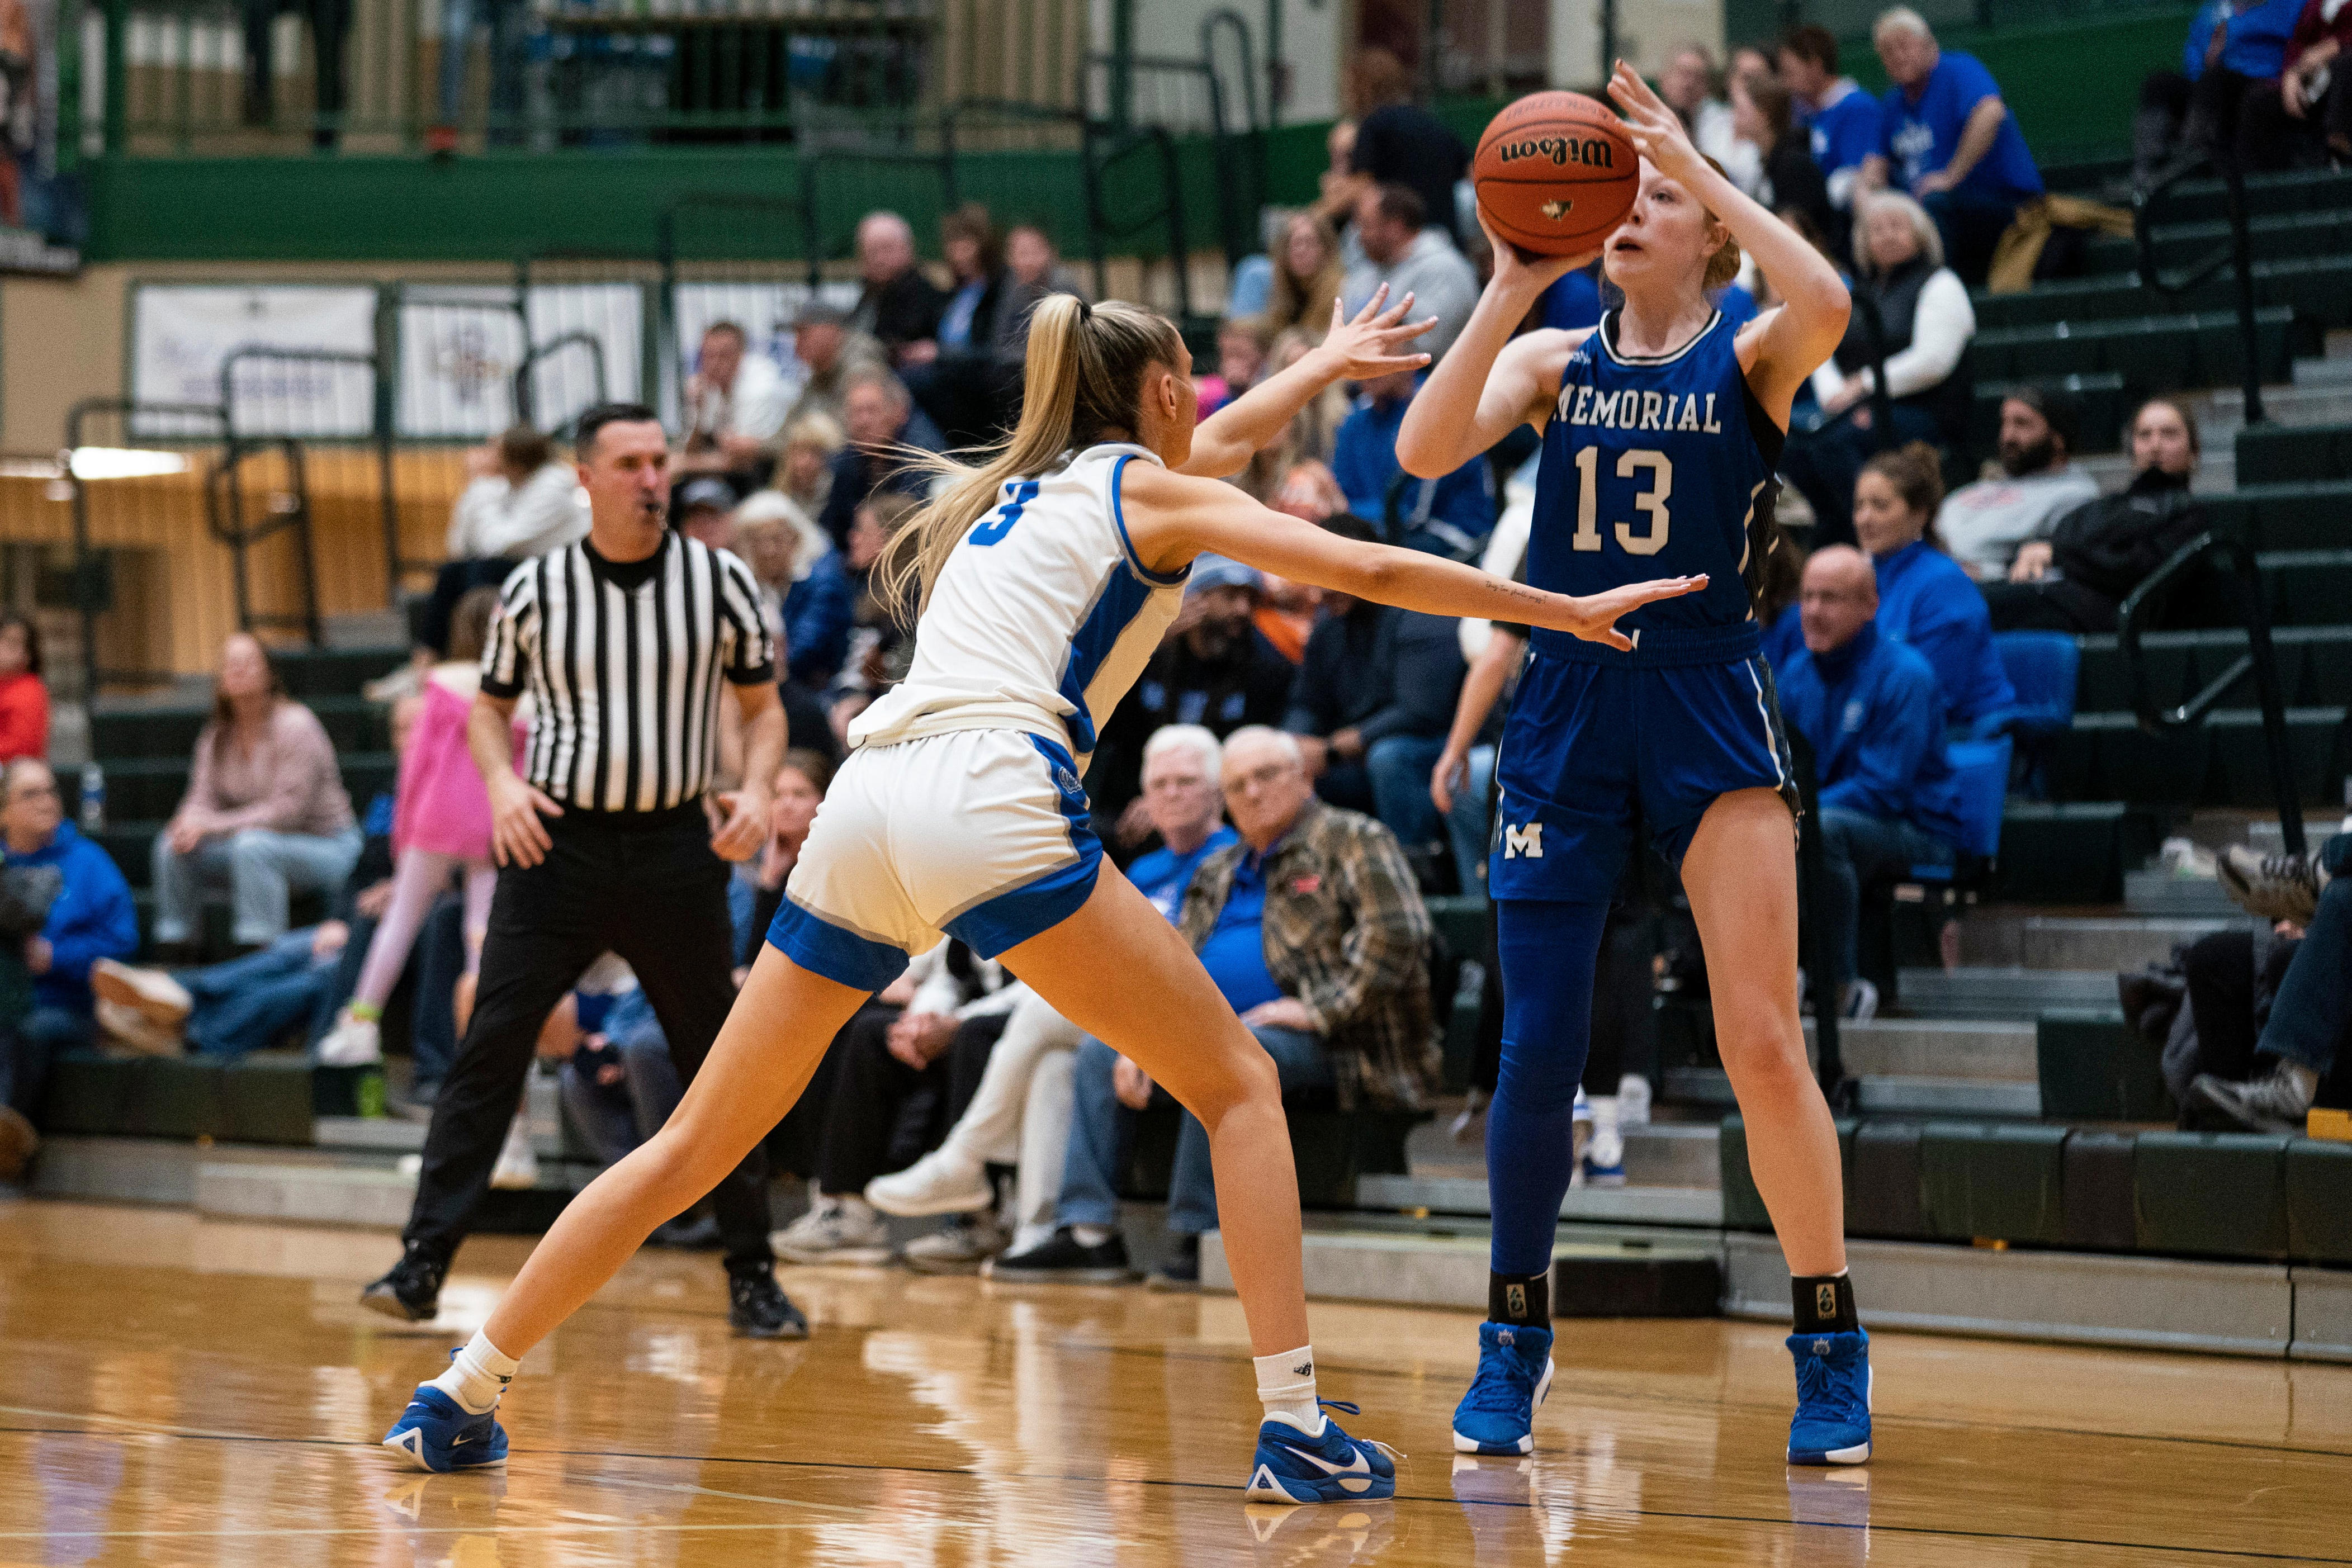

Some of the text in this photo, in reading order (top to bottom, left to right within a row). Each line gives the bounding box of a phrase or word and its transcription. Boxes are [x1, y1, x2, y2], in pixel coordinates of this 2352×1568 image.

[1501, 138, 1613, 168] Wilson
[1553, 383, 1721, 434] MEMORIAL
[968, 481, 1040, 546] 3
[1573, 445, 1672, 556] 13
[1504, 822, 1543, 859] M
